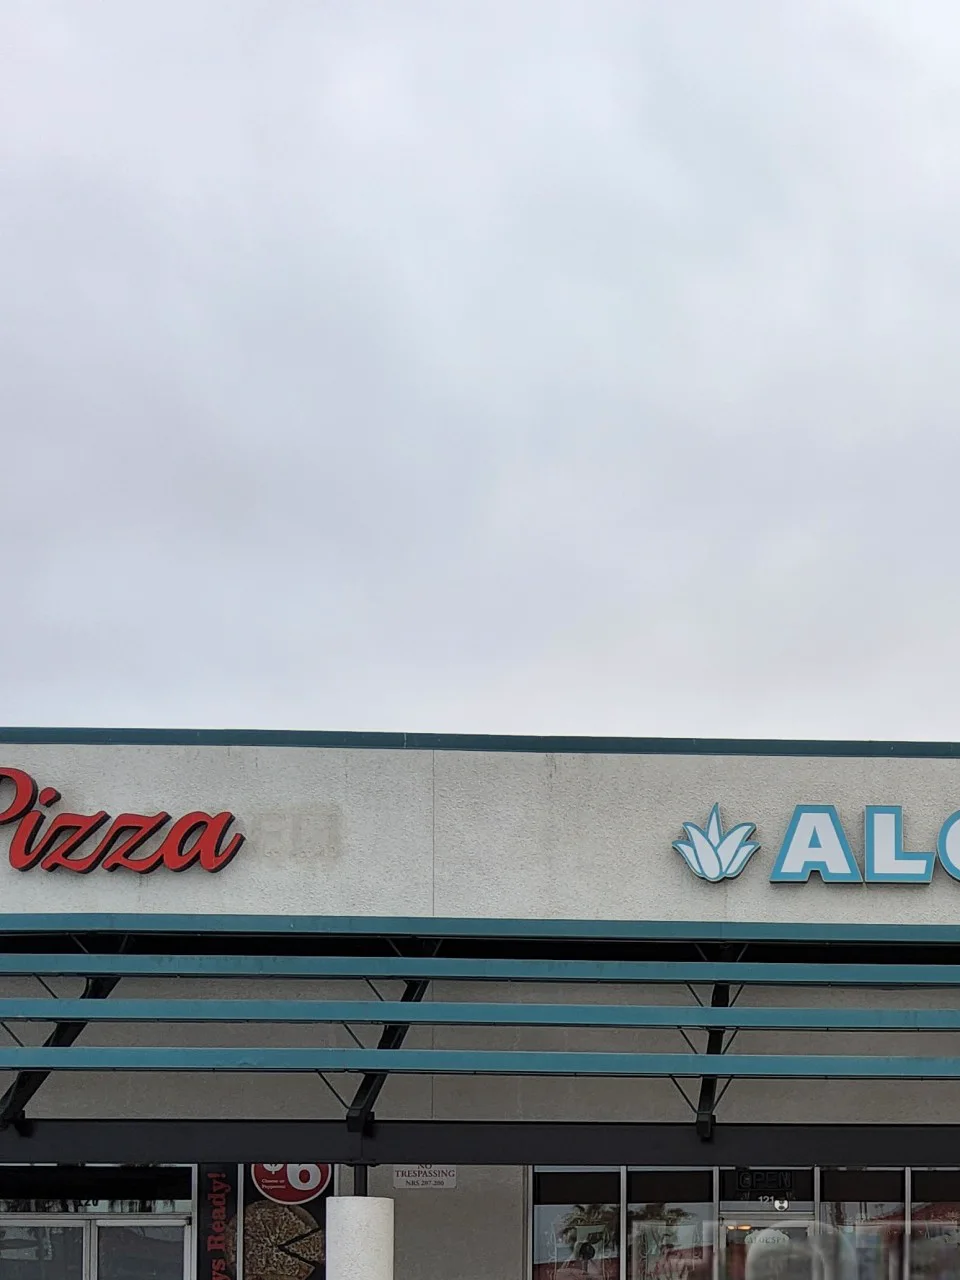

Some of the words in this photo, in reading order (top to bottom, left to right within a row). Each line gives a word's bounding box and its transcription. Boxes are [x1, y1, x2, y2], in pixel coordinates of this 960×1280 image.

[394, 1169, 456, 1178] TRESPASSING
[757, 1195, 775, 1205] 121
[206, 1171, 232, 1252] Ready!
